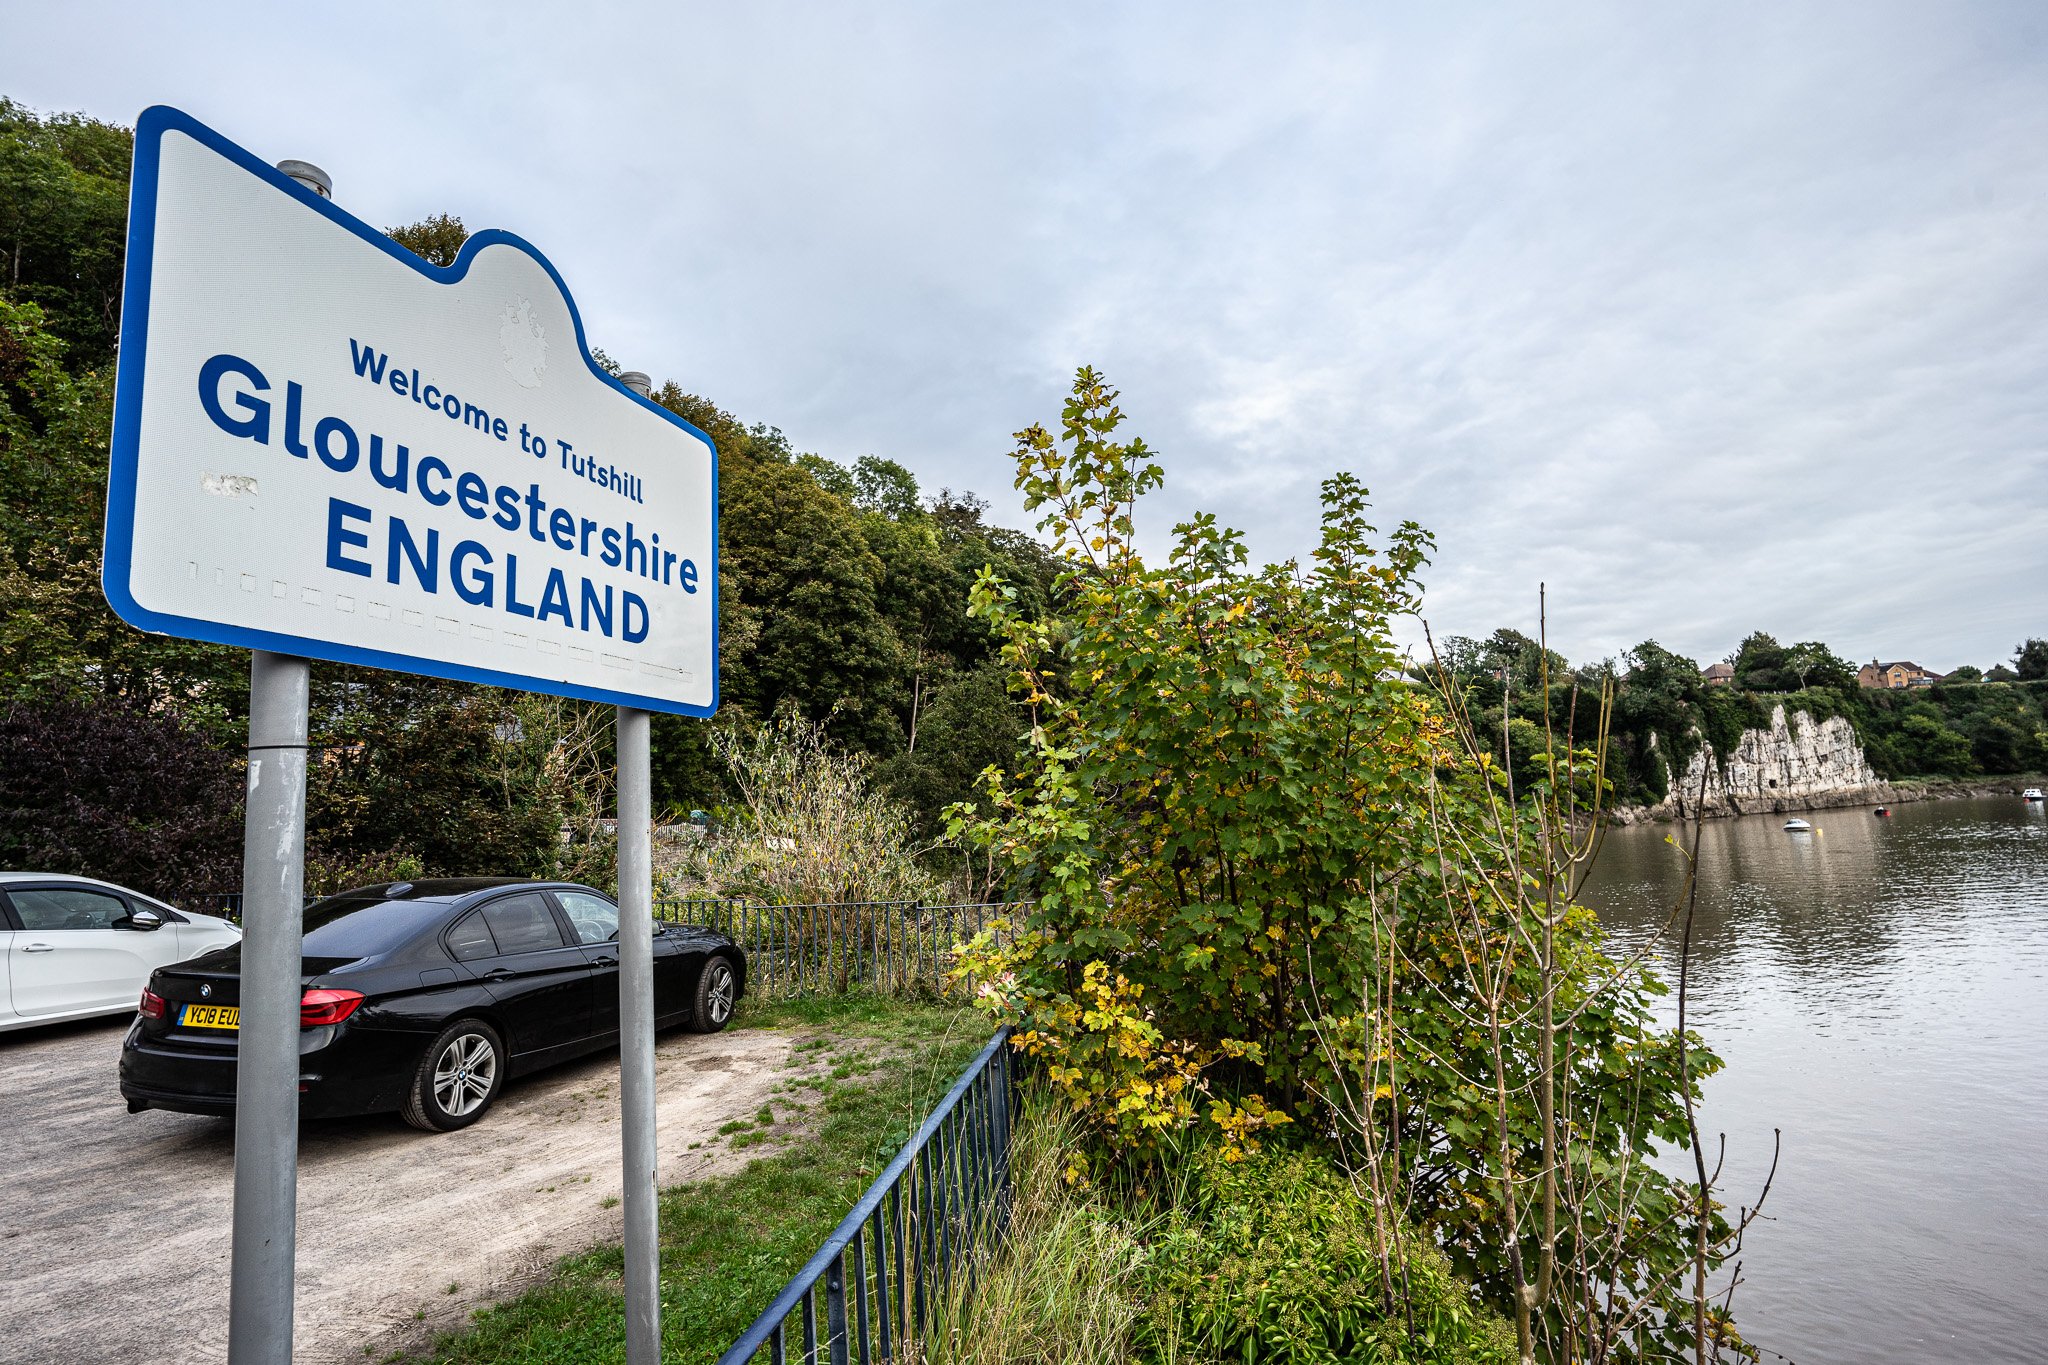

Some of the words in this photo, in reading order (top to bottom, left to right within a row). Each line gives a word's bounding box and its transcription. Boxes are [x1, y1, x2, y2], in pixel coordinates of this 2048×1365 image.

[197, 353, 699, 595] Gloucestershire
[349, 338, 510, 443] Welcome
[519, 422, 548, 460] to
[557, 438, 644, 505] Tutshill
[325, 496, 650, 644] ENGLAND
[190, 1006, 218, 1024] YC18
